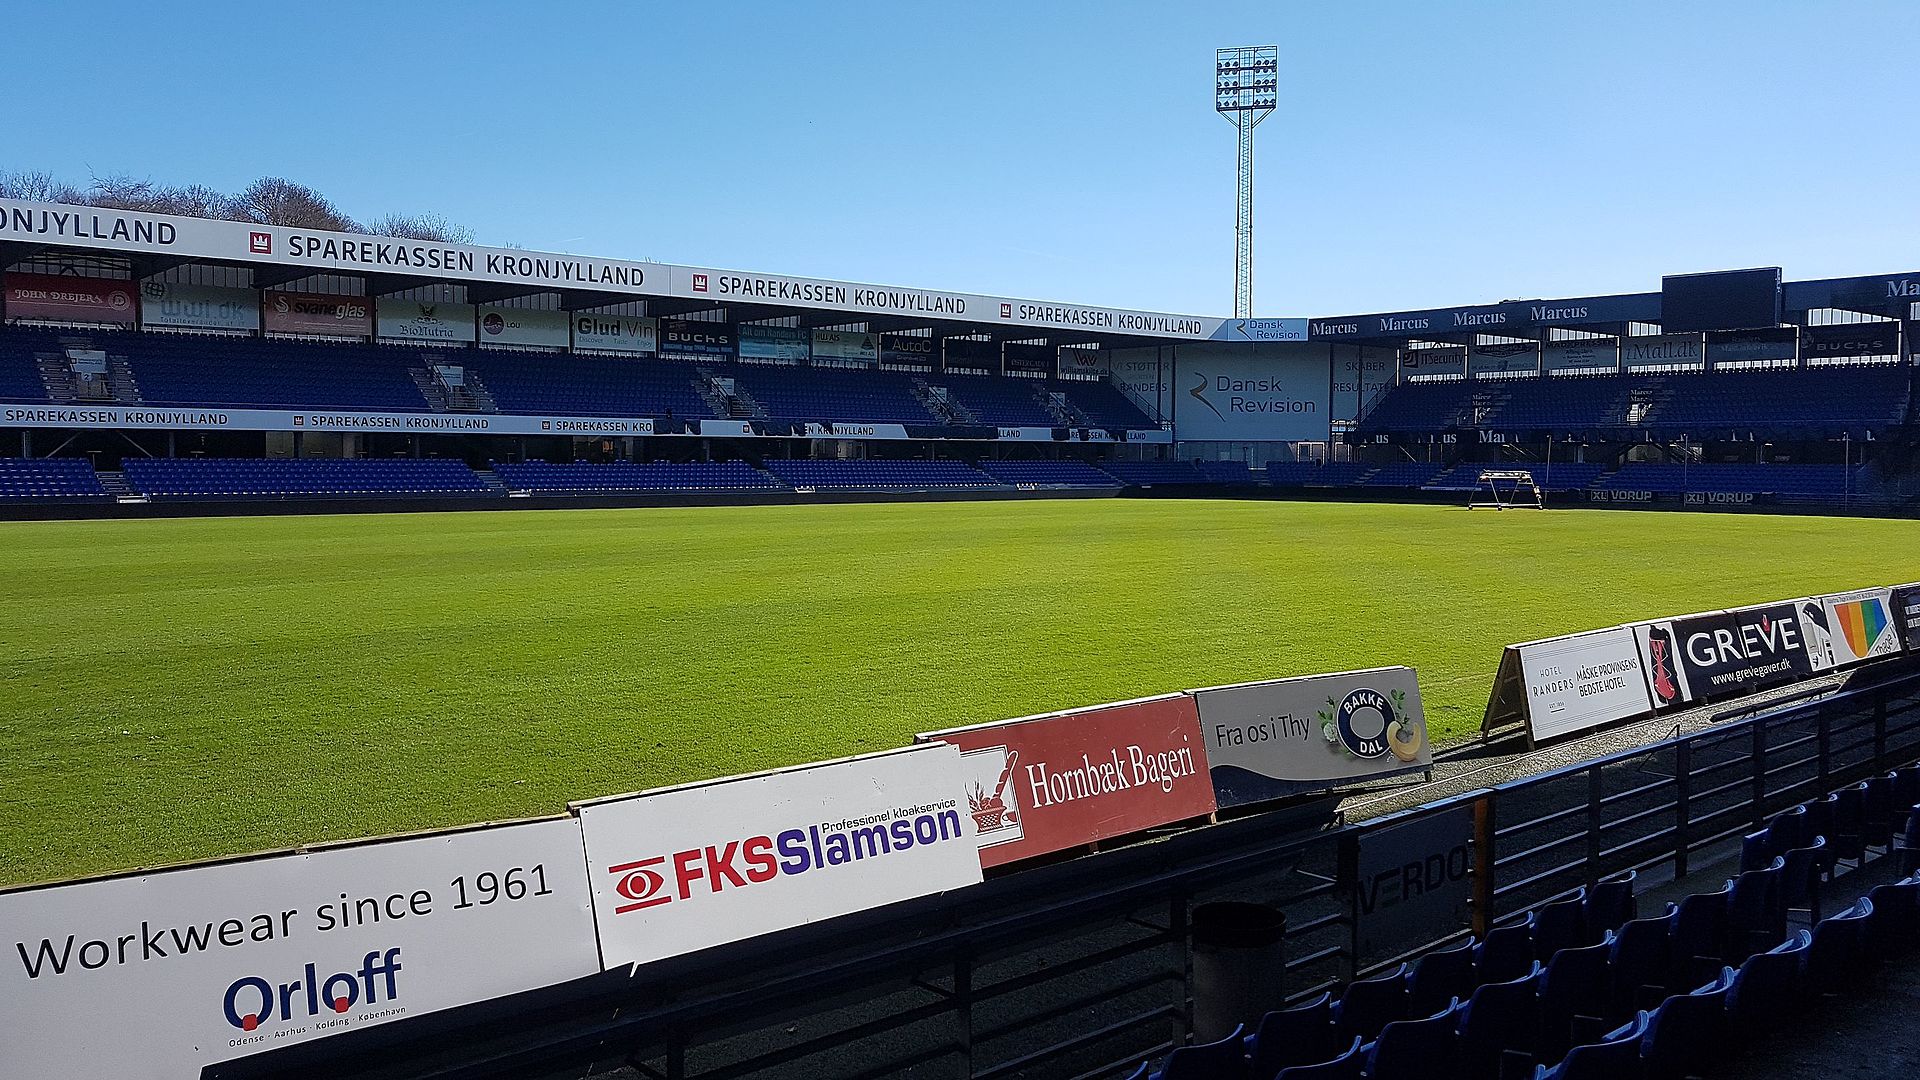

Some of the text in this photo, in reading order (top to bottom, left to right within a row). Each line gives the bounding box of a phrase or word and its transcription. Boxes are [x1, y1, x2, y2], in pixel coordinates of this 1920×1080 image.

[289, 235, 645, 287] SPAREKASSEN KRONJYLLAND
[15, 289, 47, 299] JOHN
[719, 276, 966, 314] SPAREKASSEN KRONJYLLAND
[295, 302, 365, 320] svaneglas
[1019, 304, 1202, 335] SPAREKASSEN KRONJYLLAND
[1453, 312, 1506, 326] Marcus
[1531, 306, 1588, 321] Marcus
[400, 324, 453, 338] BioNutria
[577, 317, 653, 339] Glud Vin
[1250, 320, 1284, 330] Dansk
[1312, 323, 1358, 336] Marcus
[1380, 317, 1429, 332] Marcus
[1257, 330, 1300, 339] Revision
[1126, 361, 1169, 371] STØTTR
[1217, 375, 1283, 392] Dansk
[1230, 396, 1316, 413] Revision
[5, 409, 228, 425] SPAREKASSEN KRONJYLLAND
[311, 415, 489, 429] SPAREKASSEN KRONJYLLAND
[556, 420, 628, 432] SPAREKASSEN
[817, 427, 874, 436] KRNJYLLAND
[1686, 617, 1800, 667] GREVE
[1540, 666, 1562, 678] HOTEL
[1576, 658, 1638, 681] MÅSKE PROVINSENS
[1711, 658, 1792, 685] www.grevegaver.dk
[1533, 679, 1574, 697] RANDERS
[1579, 676, 1626, 697] BEDSTE HOTEL
[1343, 692, 1385, 715] BAKKE
[1215, 713, 1310, 747] Fra os i Thy
[1359, 739, 1383, 754] DAL
[1025, 734, 1196, 809] Hornbæk Bageri
[822, 799, 957, 834] Professionel kloakservice
[16, 863, 553, 979] Workwear since 1961
[223, 947, 402, 1032] Orloff
[229, 1006, 406, 1048] Odense Aarhus Kolding København
